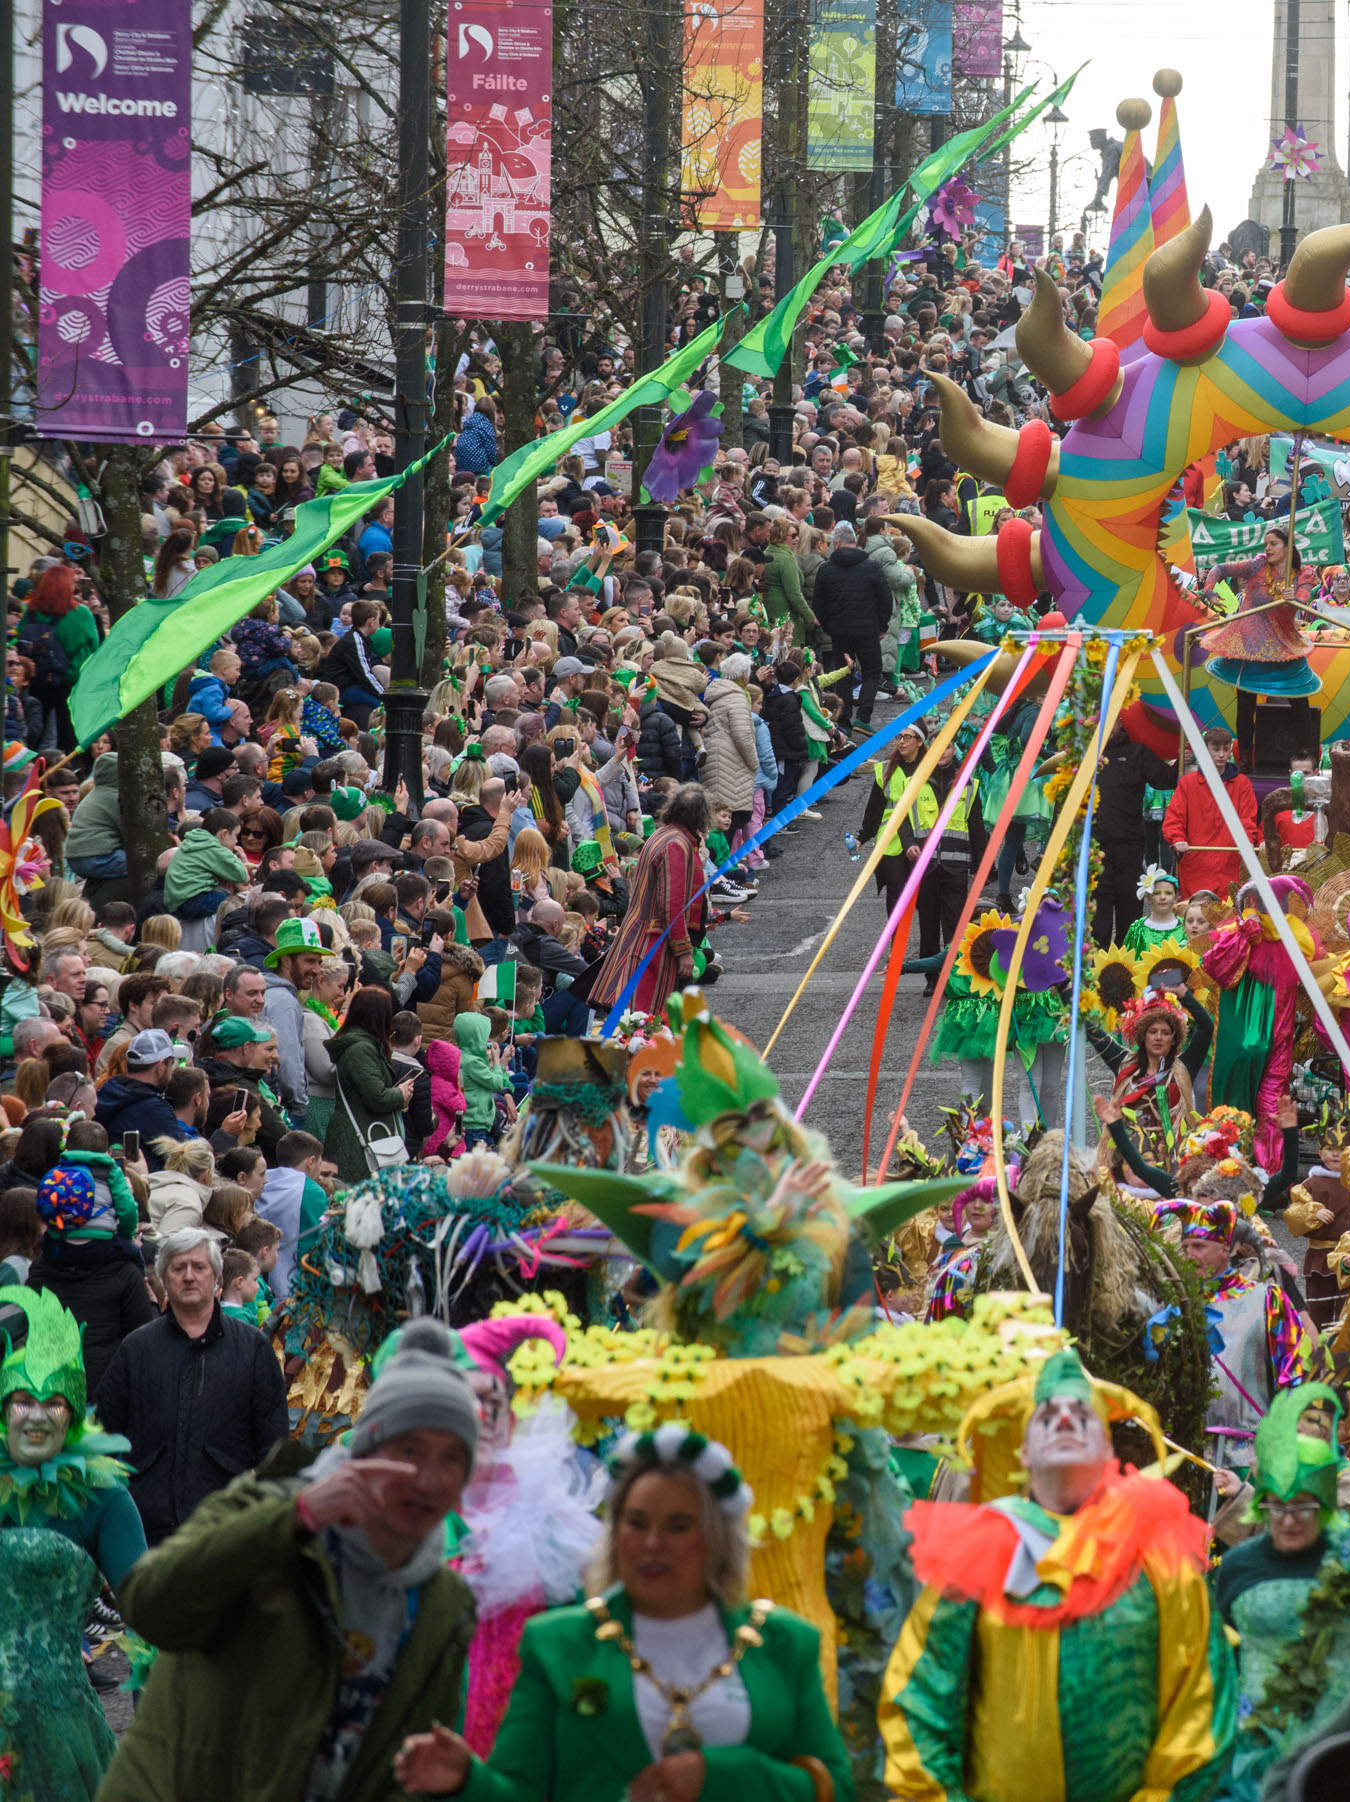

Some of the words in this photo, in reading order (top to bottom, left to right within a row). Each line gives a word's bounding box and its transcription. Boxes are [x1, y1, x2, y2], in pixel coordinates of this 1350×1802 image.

[472, 73, 528, 91] Fáilte
[55, 91, 177, 118] Welcome
[456, 284, 538, 293] derrystrabane.com
[53, 392, 173, 406] derrystrabane.com
